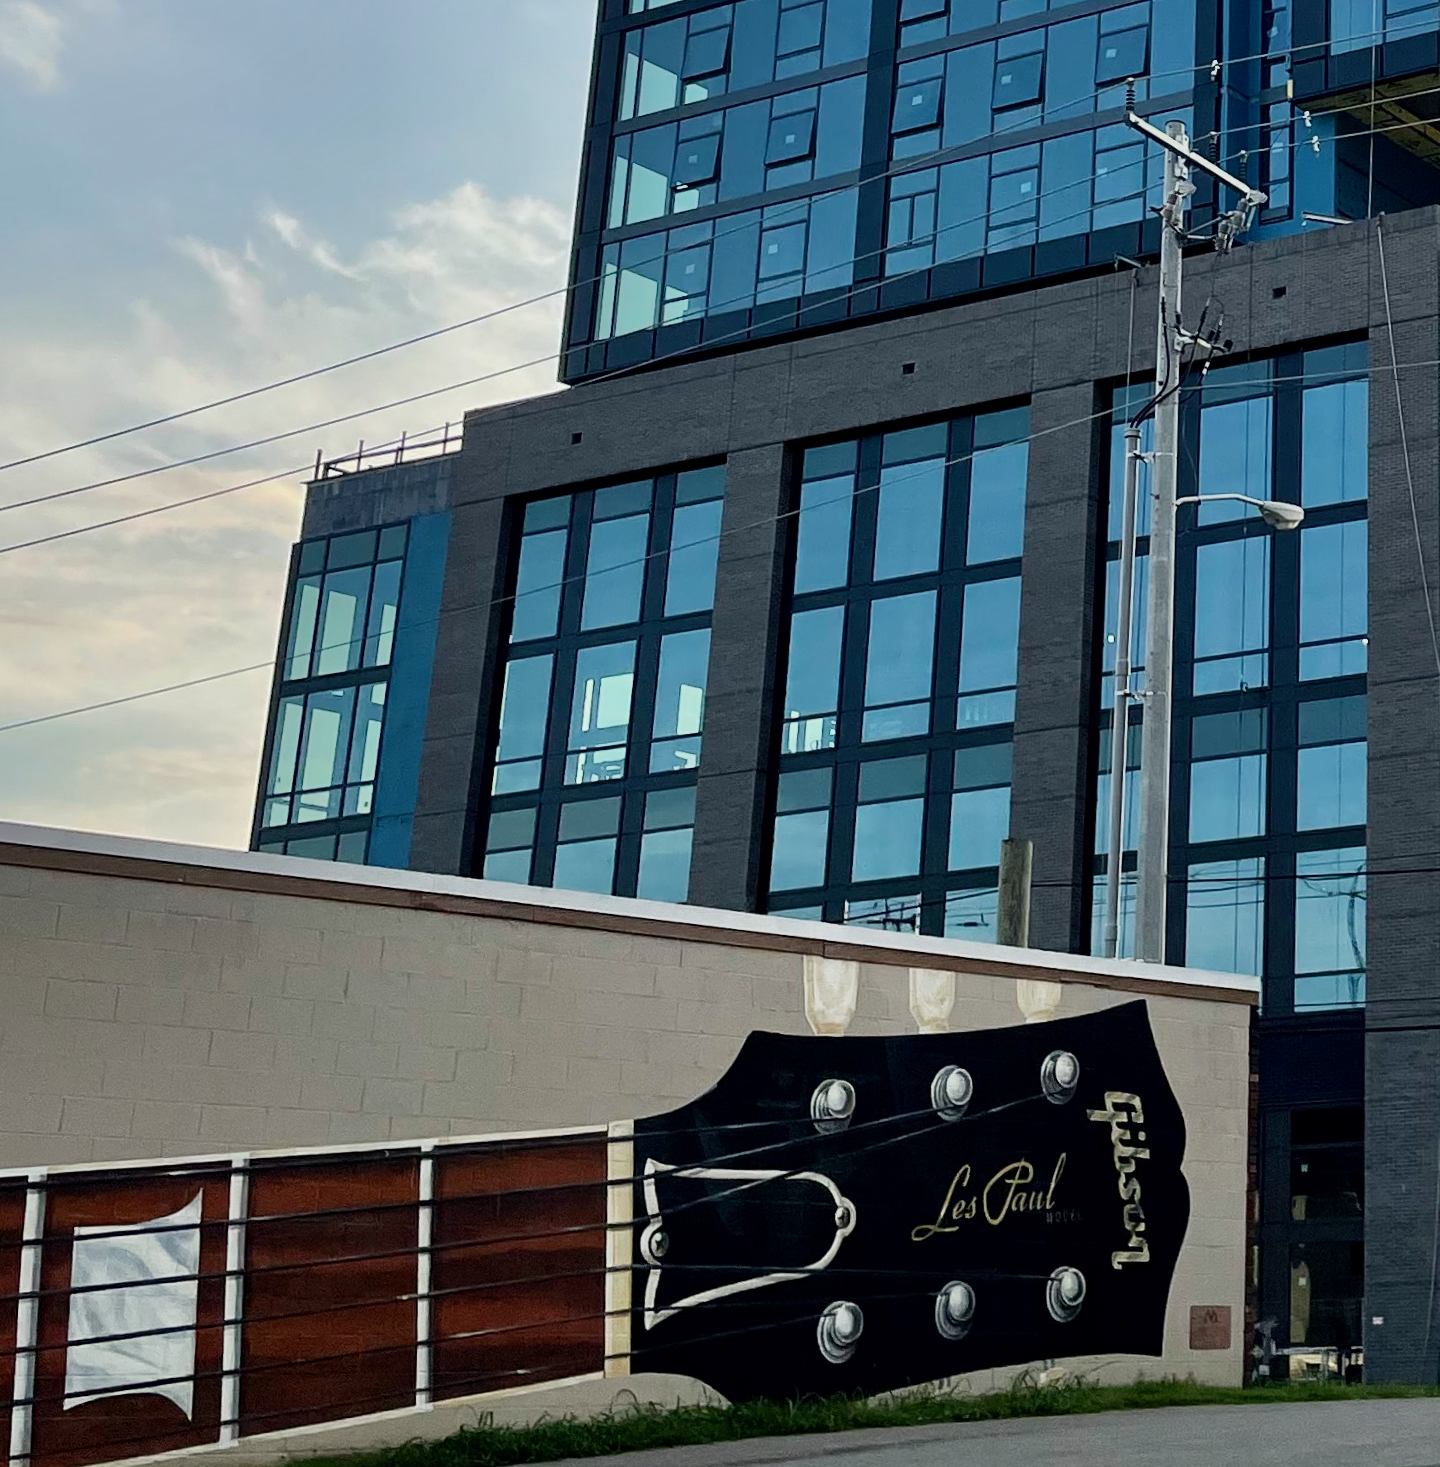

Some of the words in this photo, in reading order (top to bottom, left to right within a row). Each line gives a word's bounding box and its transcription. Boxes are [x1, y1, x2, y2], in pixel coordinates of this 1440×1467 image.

[911, 1163, 977, 1242] Les
[982, 1151, 1067, 1226] Paul
[1086, 1090, 1151, 1271] Gibson
